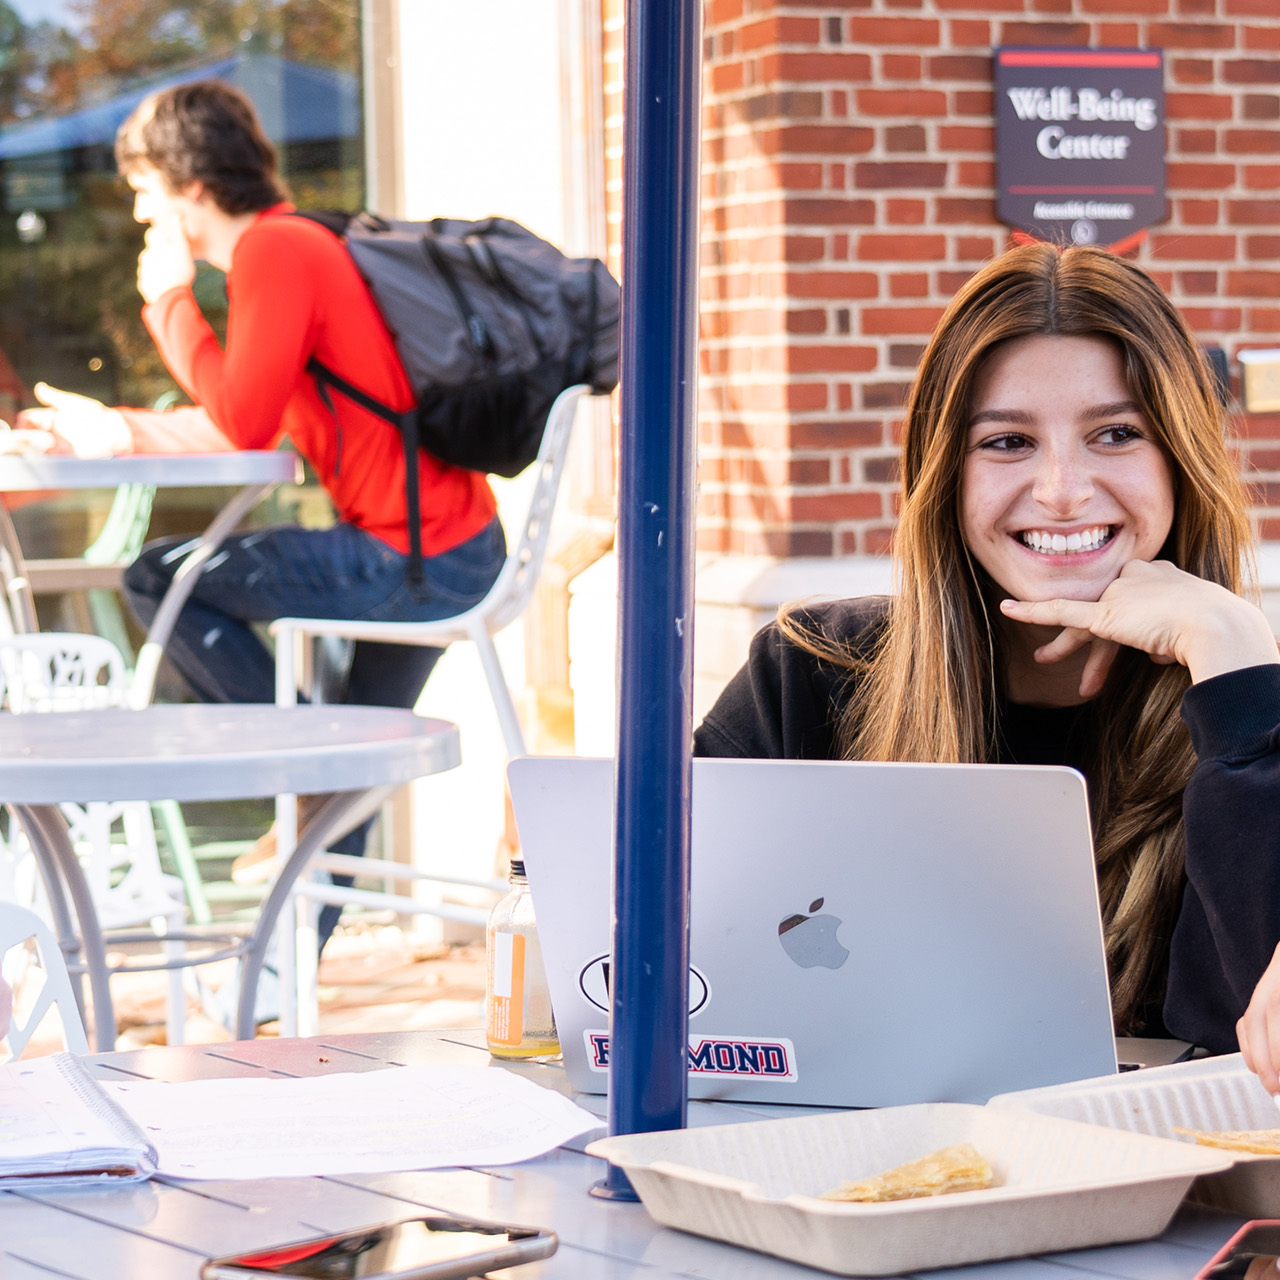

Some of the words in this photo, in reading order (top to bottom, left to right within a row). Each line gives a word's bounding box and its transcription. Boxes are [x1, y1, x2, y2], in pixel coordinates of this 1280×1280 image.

[1007, 86, 1157, 131] Well-Being
[1036, 125, 1131, 160] Center
[590, 1035, 789, 1076] RMOND
